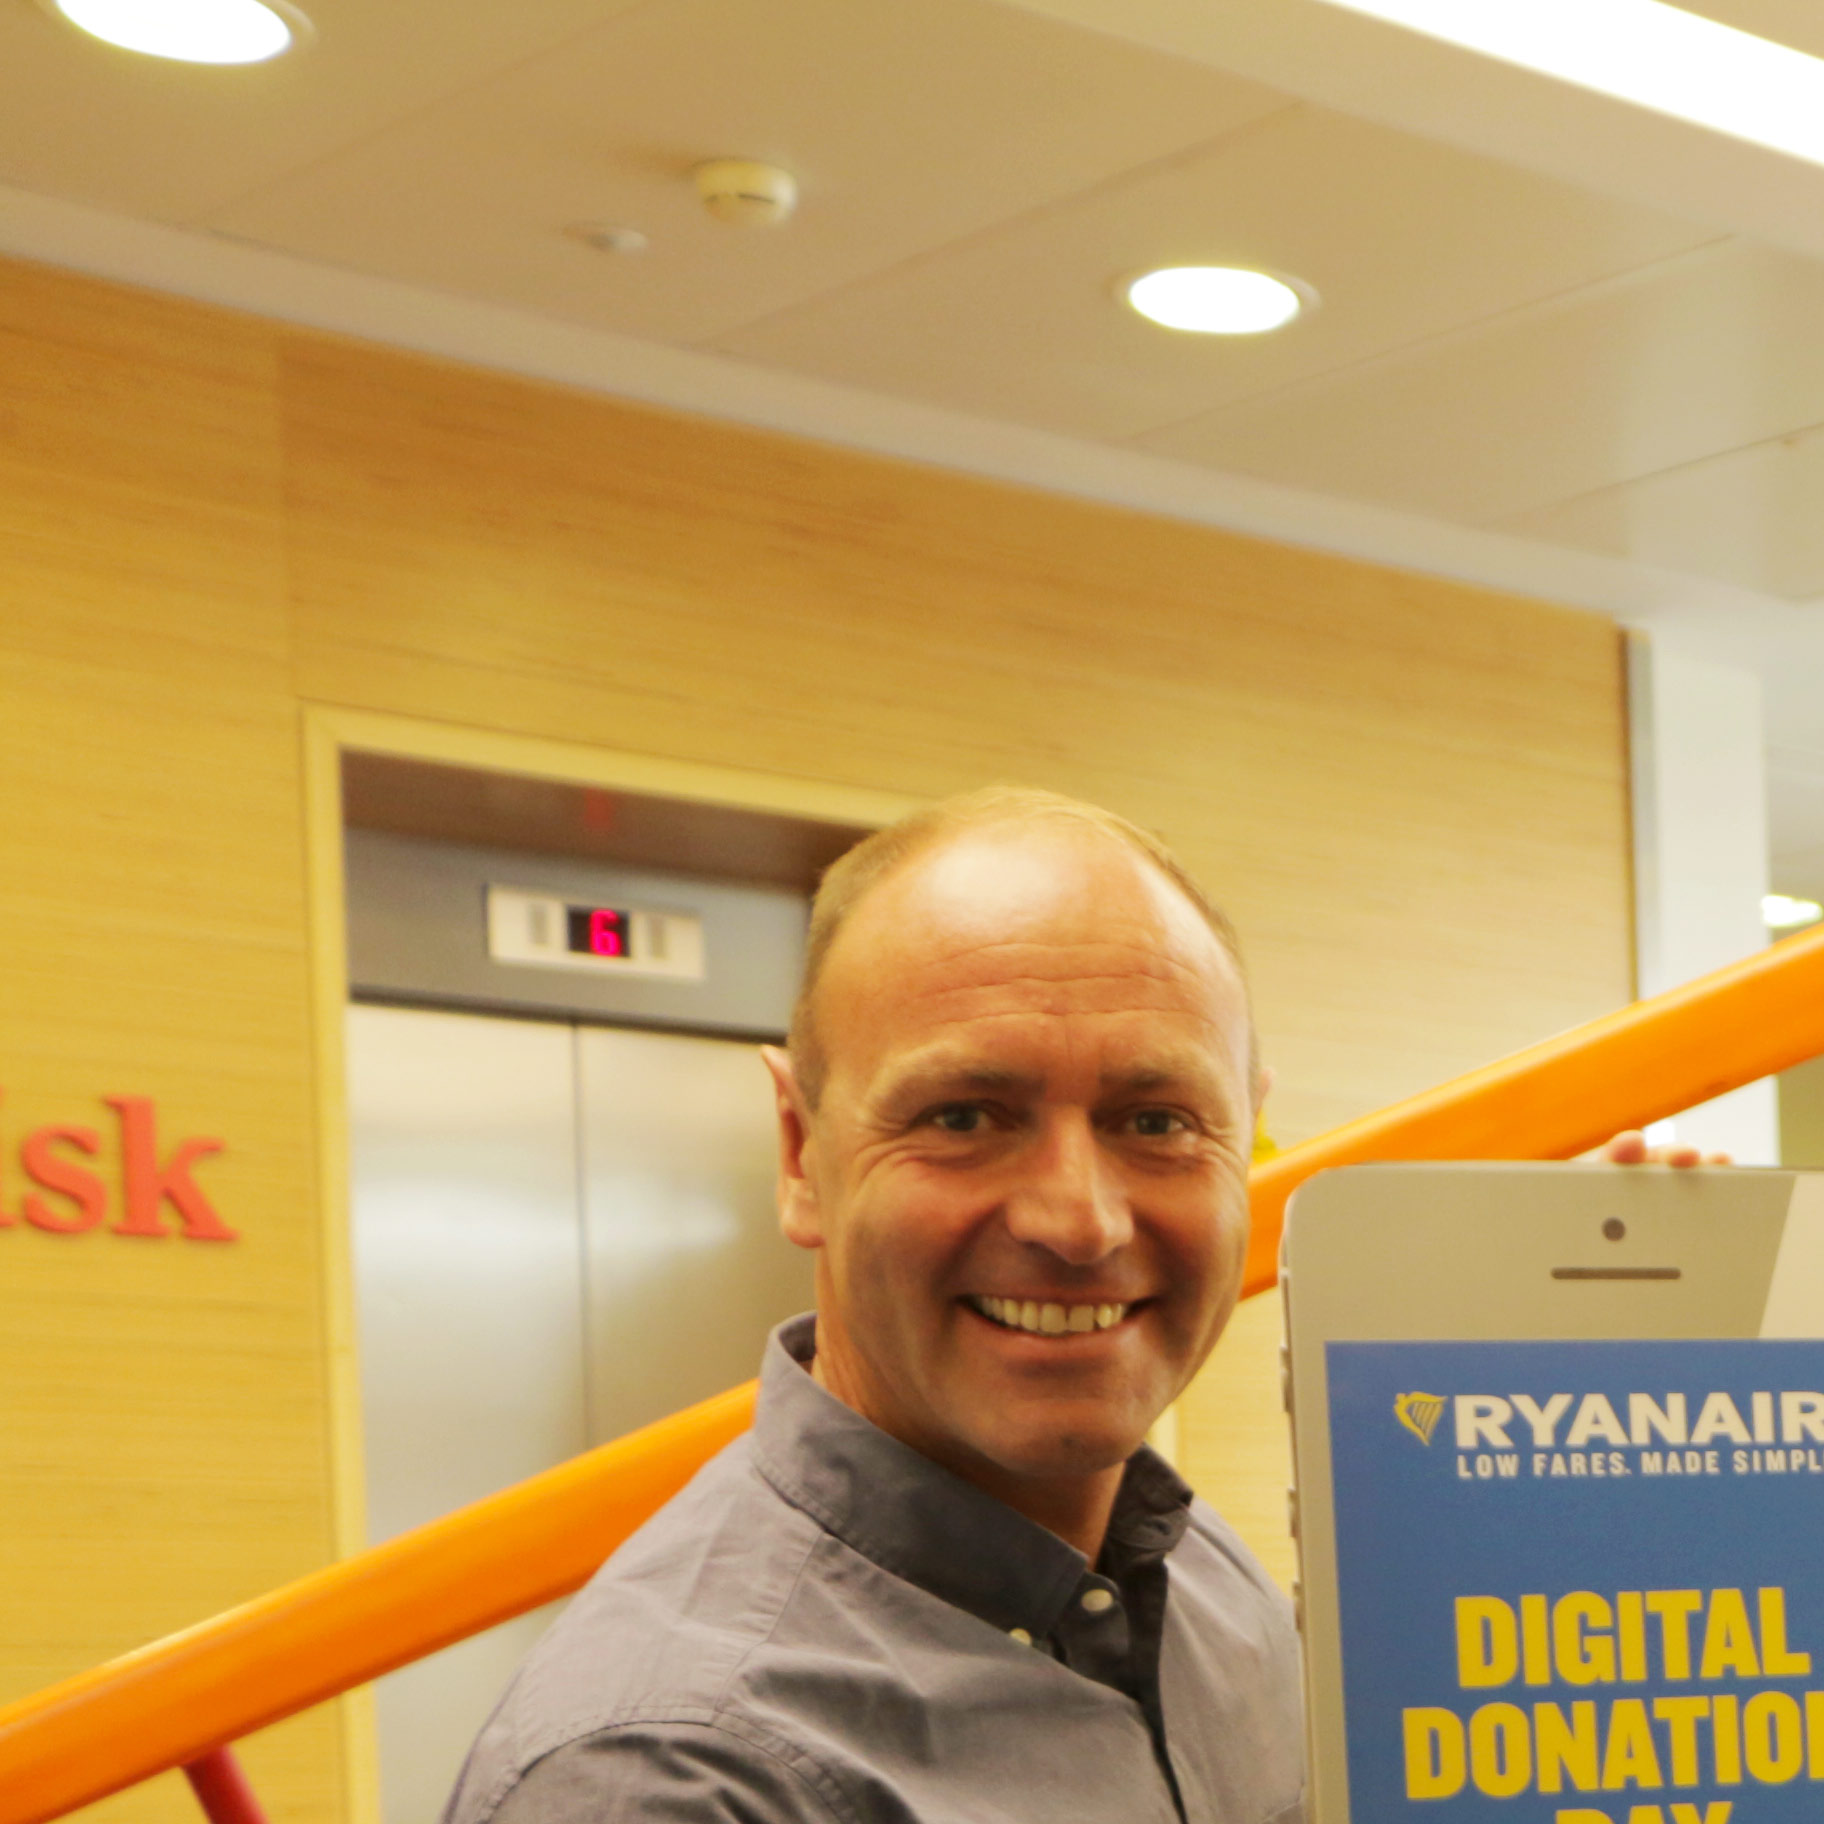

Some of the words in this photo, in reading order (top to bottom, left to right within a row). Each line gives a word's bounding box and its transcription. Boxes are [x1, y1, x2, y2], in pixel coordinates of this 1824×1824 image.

[588, 907, 622, 958] 6
[0, 1086, 241, 1243] sk
[1457, 1453, 1519, 1479] LOW
[1533, 1452, 1631, 1477] FARES.
[1641, 1450, 1720, 1475] MADE
[1454, 1586, 1812, 1689] DIGITAL
